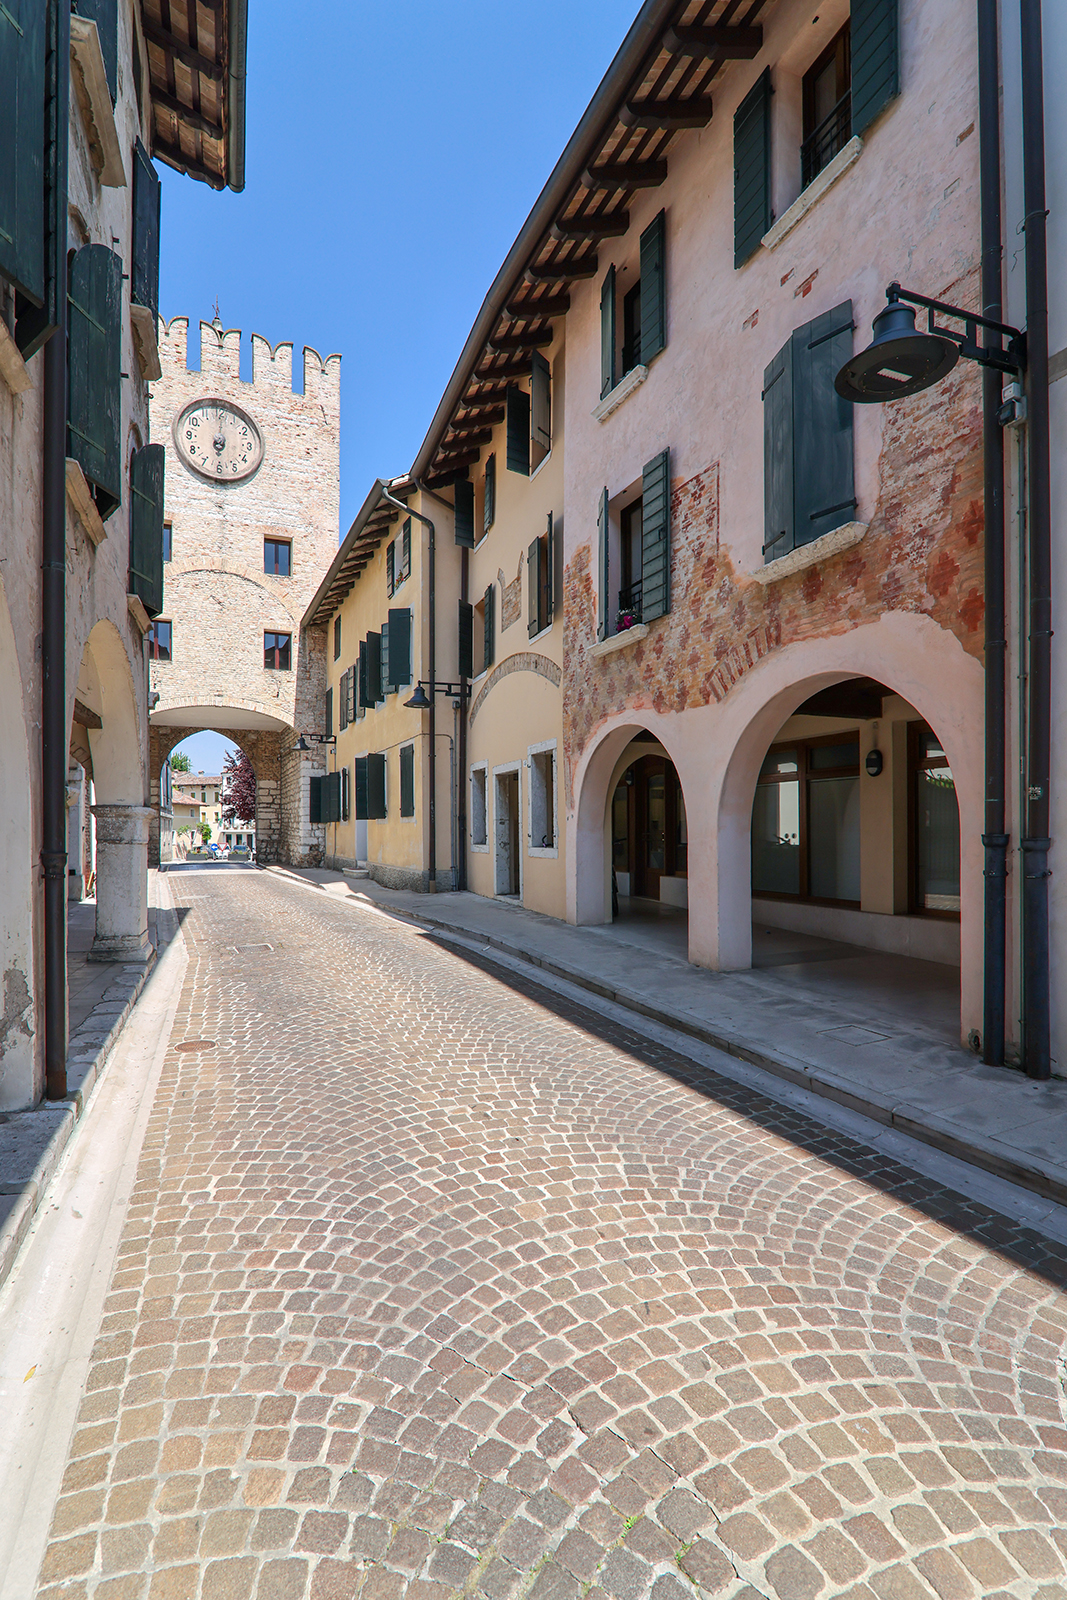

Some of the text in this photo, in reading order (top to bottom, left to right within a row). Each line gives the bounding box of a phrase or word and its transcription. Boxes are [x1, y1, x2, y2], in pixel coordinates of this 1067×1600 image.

[202, 408, 208, 417] 11
[216, 408, 224, 417] 12
[189, 417, 198, 426] 10
[186, 430, 192, 440] 9
[242, 427, 248, 436] 2
[190, 445, 196, 454] 8
[246, 442, 252, 451] 3
[201, 457, 207, 466] 7
[241, 454, 248, 464] 4
[216, 464, 222, 474] 6
[232, 463, 237, 472] 5
